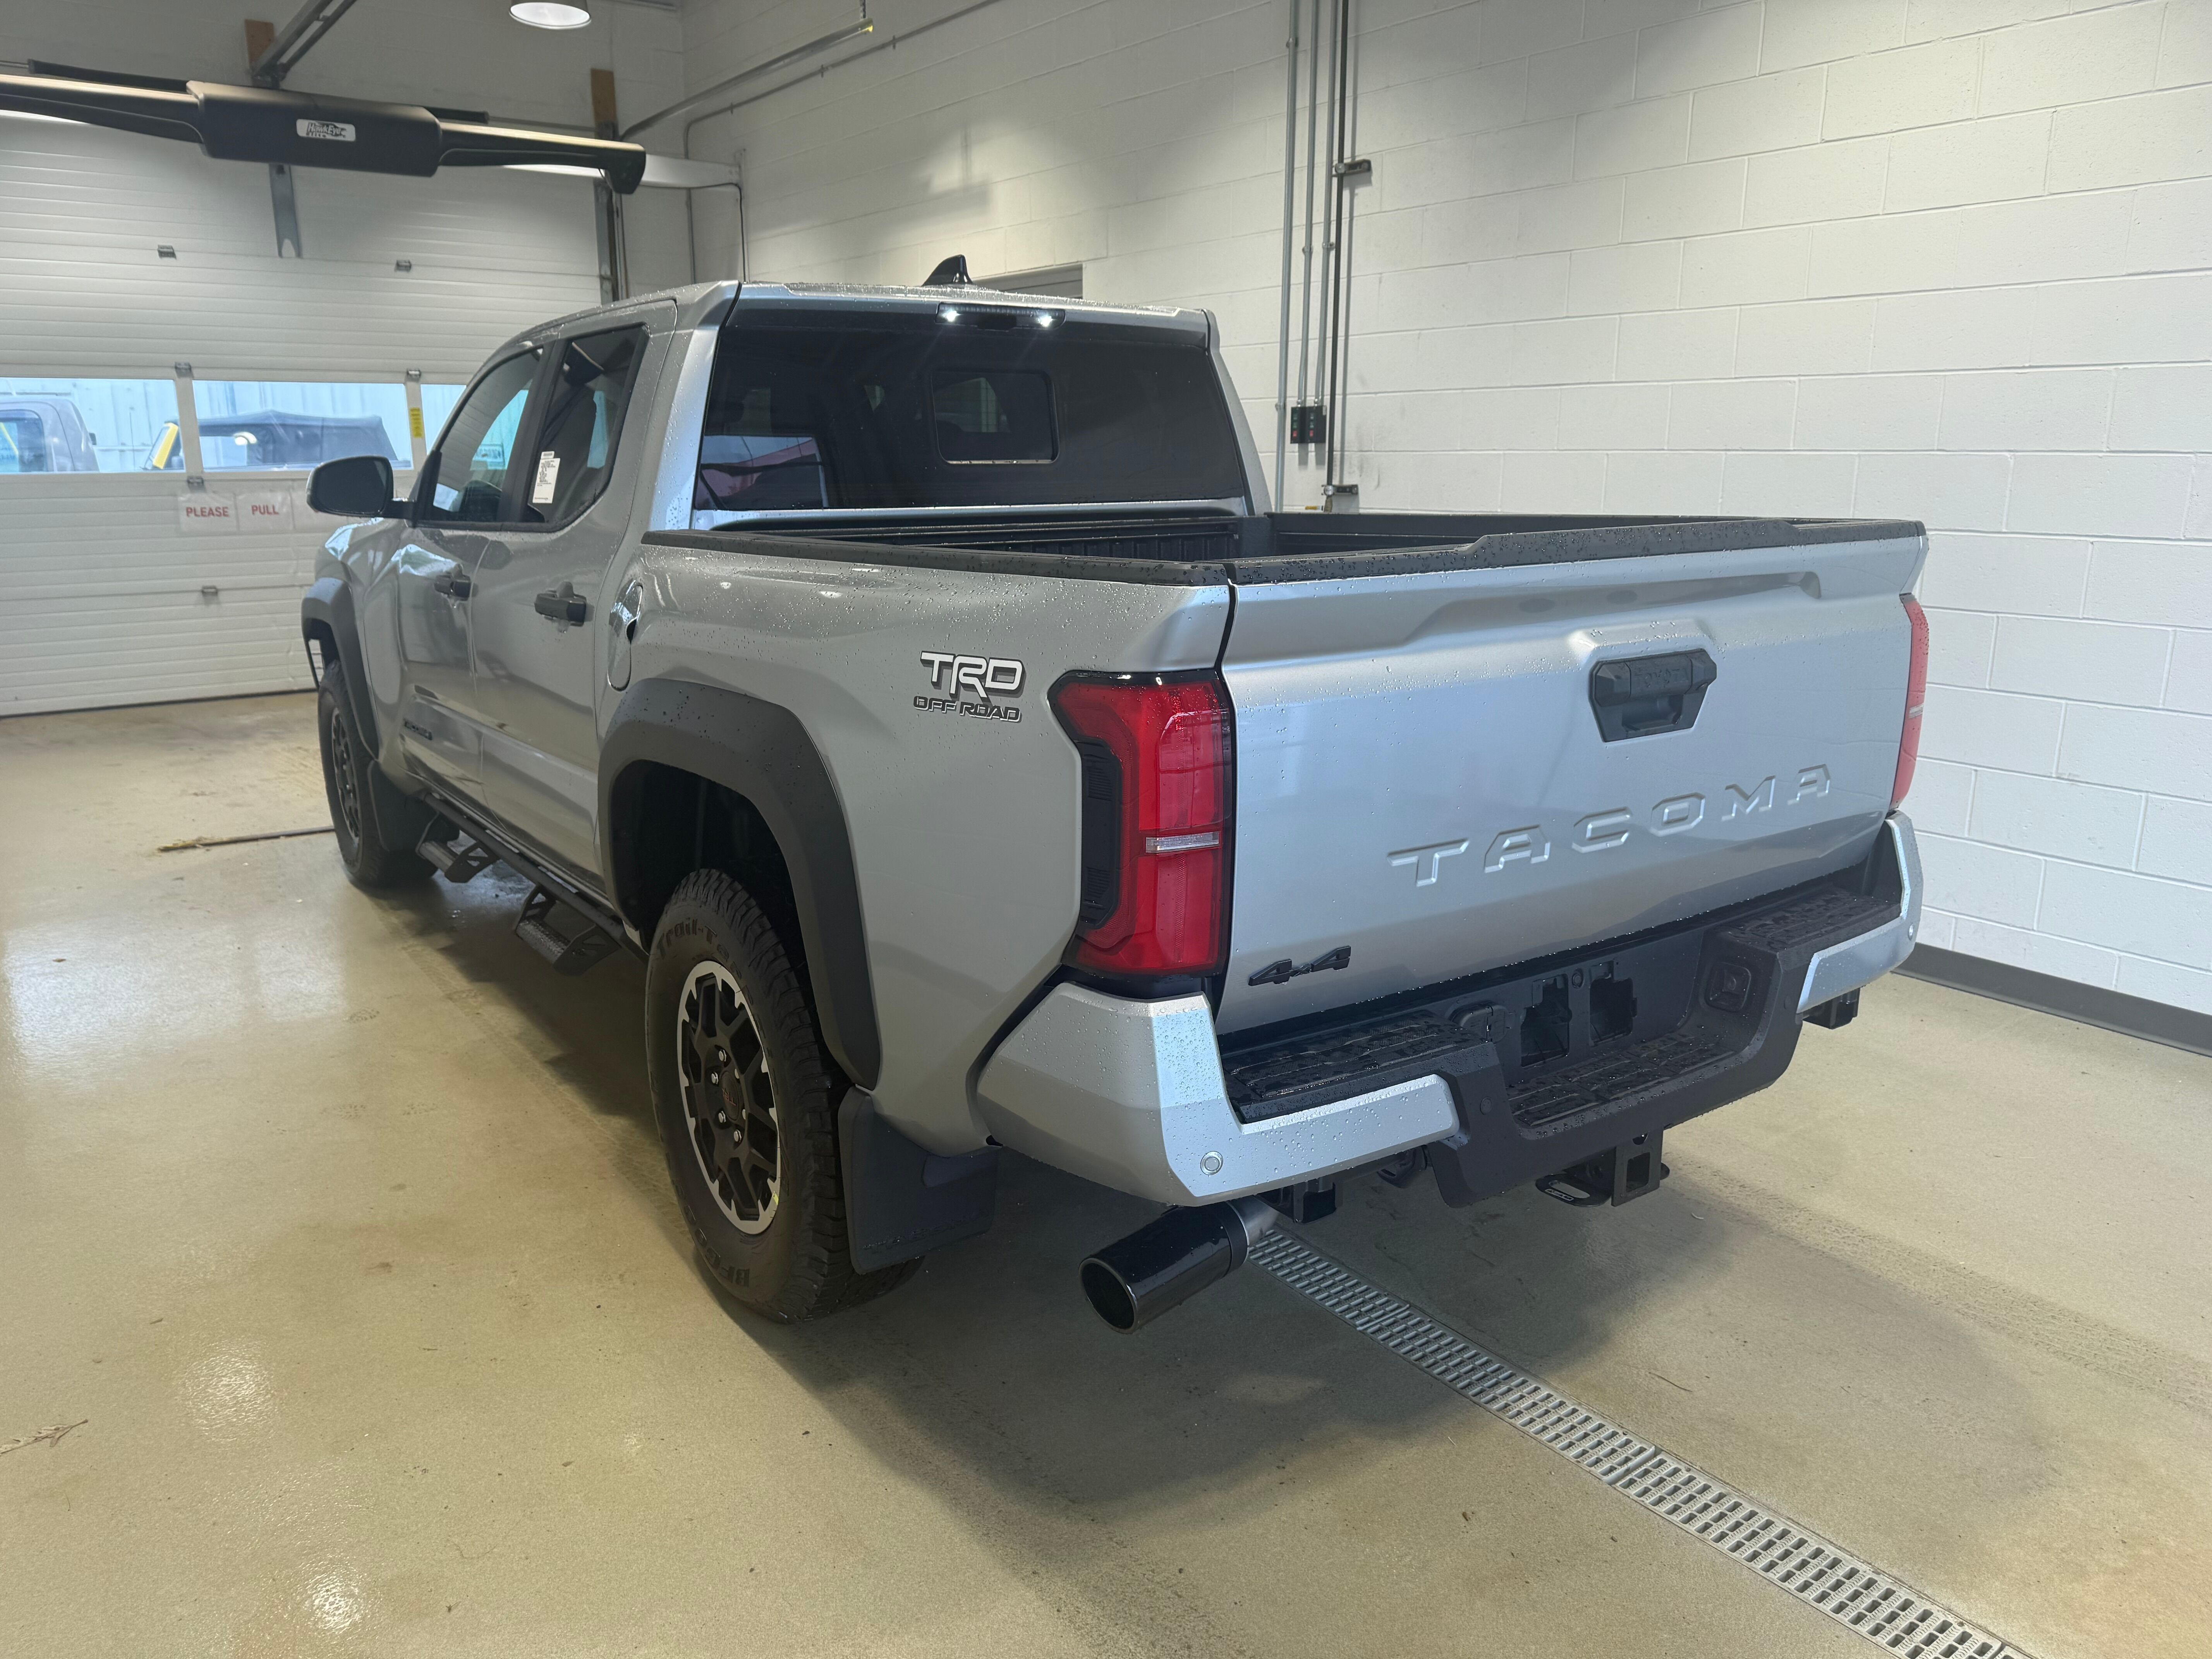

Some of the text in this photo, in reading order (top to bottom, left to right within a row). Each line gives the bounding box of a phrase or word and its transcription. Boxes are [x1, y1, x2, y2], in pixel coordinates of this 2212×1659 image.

[186, 505, 278, 517] PLEASE PULL
[921, 651, 1025, 699] TRD
[1634, 667, 1689, 689] TOYOTA
[914, 696, 1022, 723] OFF ROAD
[1387, 764, 1831, 887] TACOMA
